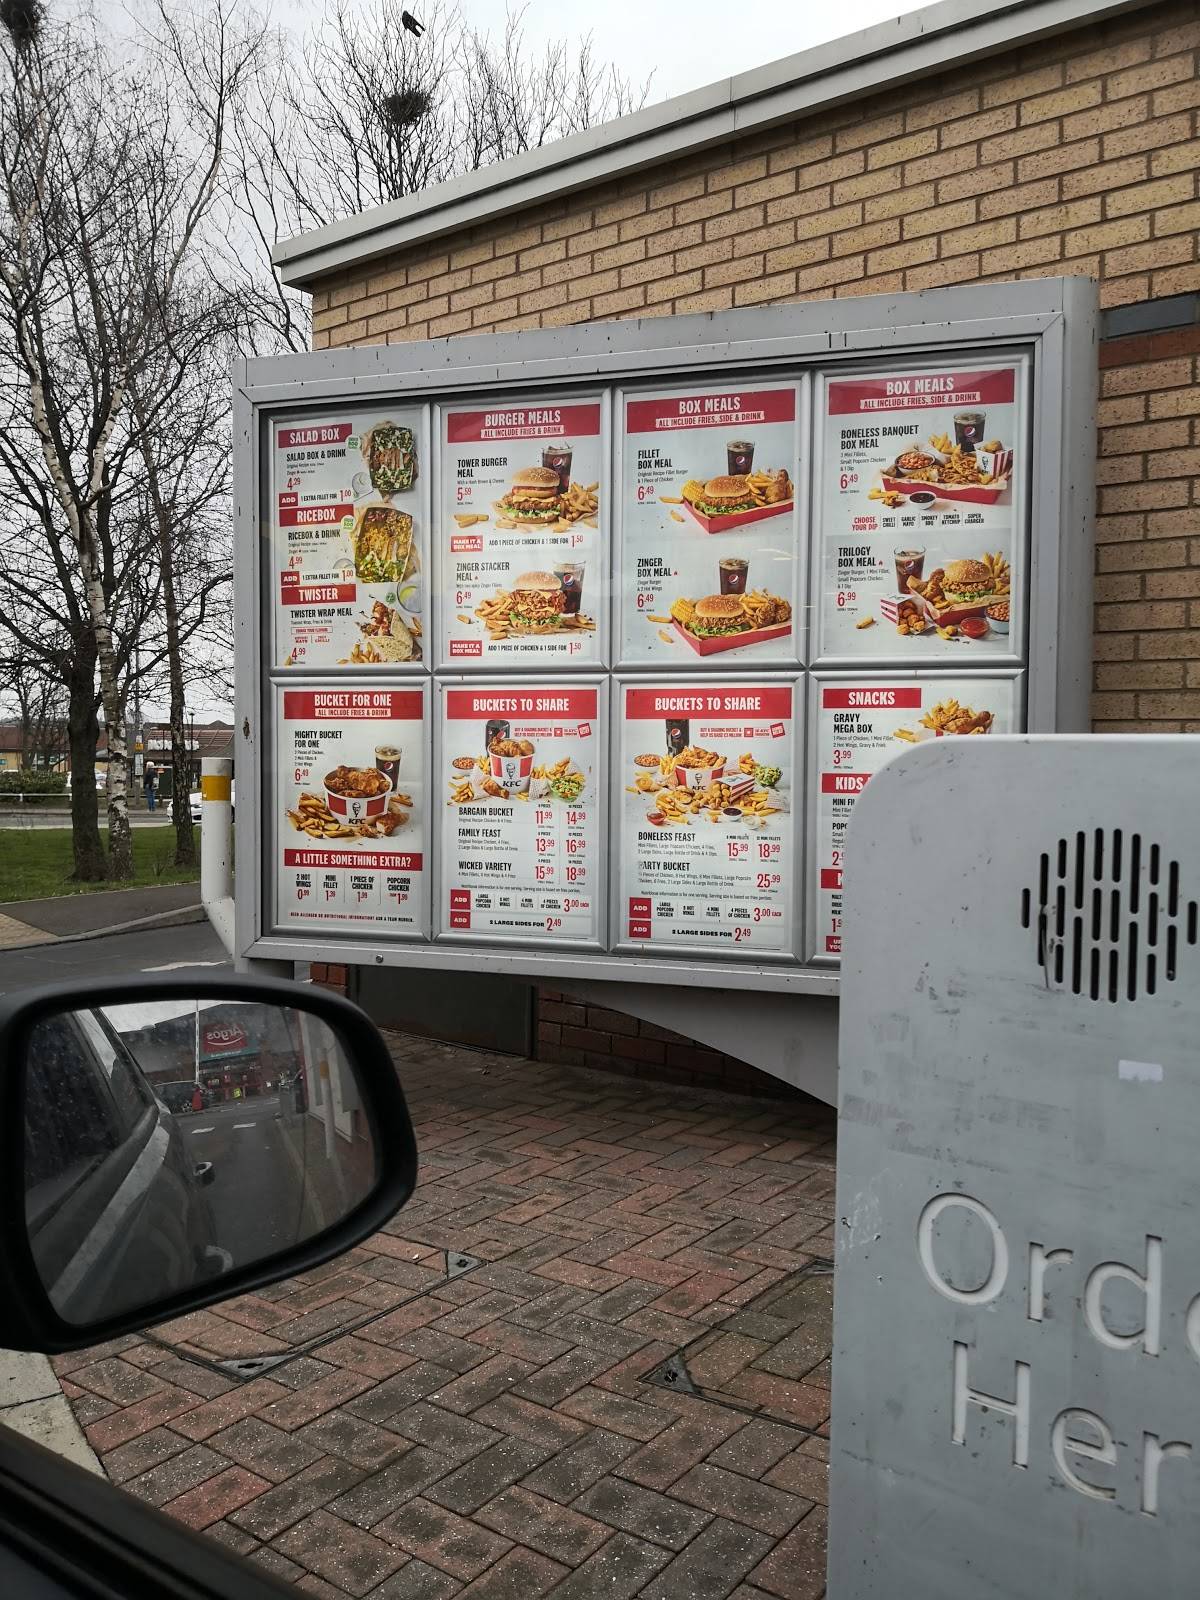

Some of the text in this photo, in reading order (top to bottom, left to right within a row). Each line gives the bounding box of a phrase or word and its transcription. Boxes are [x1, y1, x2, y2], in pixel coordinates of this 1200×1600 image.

[887, 377, 954, 395] BOX MEALS
[679, 397, 741, 414] BOX MEALS
[864, 400, 874, 408] ALL
[877, 398, 905, 407] INCLUDE
[907, 397, 929, 406] FRIES,
[931, 395, 946, 403] SIDE
[955, 393, 977, 402] DRINK
[485, 410, 561, 426] BURGER MEALS
[659, 419, 669, 427] ALL
[671, 417, 696, 426] INCLUDE
[698, 416, 718, 424] FRIES,
[719, 415, 733, 423] SIDE
[742, 413, 761, 421] DRINK
[290, 428, 339, 444] SALAD BOX
[496, 428, 519, 437] INCLUDE
[520, 427, 536, 435] FRIES
[544, 426, 561, 434] DRINK
[841, 425, 919, 439] BONELESS BANQUET
[841, 438, 879, 450] BOX MEAL
[287, 452, 305, 461] SALAD
[307, 451, 319, 460] BOX
[327, 449, 346, 458] DRINK
[638, 449, 660, 459] FILLET
[458, 457, 507, 468] TOWER BURGER
[638, 458, 672, 469] BOX MEAL
[458, 469, 473, 477] MEAL
[840, 473, 858, 489] 6.49
[457, 487, 471, 500] 5.59
[638, 486, 654, 500] 6.49
[297, 508, 335, 522] RICEBOX
[288, 531, 313, 540] RICEBOX
[322, 529, 340, 538] DRINK
[838, 546, 871, 557] TRILOGY
[289, 556, 302, 569] 4.99
[456, 562, 510, 571] ZINGER STACKER
[637, 558, 662, 567] ZINGER
[838, 557, 876, 567] BOX MEAL
[456, 572, 472, 581] MEAL
[637, 568, 671, 577] BOX MEAL
[299, 588, 338, 601] TWISTER
[456, 591, 471, 604] 6.49
[637, 594, 653, 608] 6.49
[837, 592, 856, 607] 6.99
[291, 608, 352, 618] TWISTER WRAP MEAL
[292, 648, 305, 660] 4.99
[570, 643, 581, 654] 1.50
[314, 694, 392, 706] BUCKET FOR ONE
[473, 698, 569, 711] BUCKETS TO SHARE
[655, 697, 760, 711] BUCKETS TO SHARE
[848, 692, 895, 705] SNACKS
[834, 714, 860, 722] GRAVY
[320, 730, 342, 738] BUCKET
[834, 724, 872, 733] MEGA BOX
[295, 740, 319, 748] FOR ONE
[834, 750, 851, 764] 3.99
[835, 777, 864, 790] KIDS
[459, 807, 513, 817] BARGAIN BUCKET
[536, 811, 552, 824] 11.99
[566, 811, 586, 825] 14.99
[458, 829, 501, 837] FAMILY FEAST
[638, 832, 695, 842] BONELESS FEAST
[536, 838, 554, 852] 13.99
[566, 839, 586, 852] 16.99
[727, 843, 748, 857] 15.99
[758, 843, 780, 858] 18.99
[295, 853, 412, 867] A LITTLE SOMETHING EXTRA?
[459, 861, 512, 871] WICKED VARIETY
[663, 862, 690, 871] BUCKET
[535, 866, 554, 879] 15.99
[566, 867, 586, 880] 18.99
[757, 874, 780, 888] 25.99
[298, 889, 309, 899] 0.99
[564, 899, 579, 912] 3.00
[754, 908, 771, 922] 3.00
[546, 918, 561, 931] 2.49
[735, 928, 751, 942] 2.49
[918, 1191, 1200, 1357] Ord
